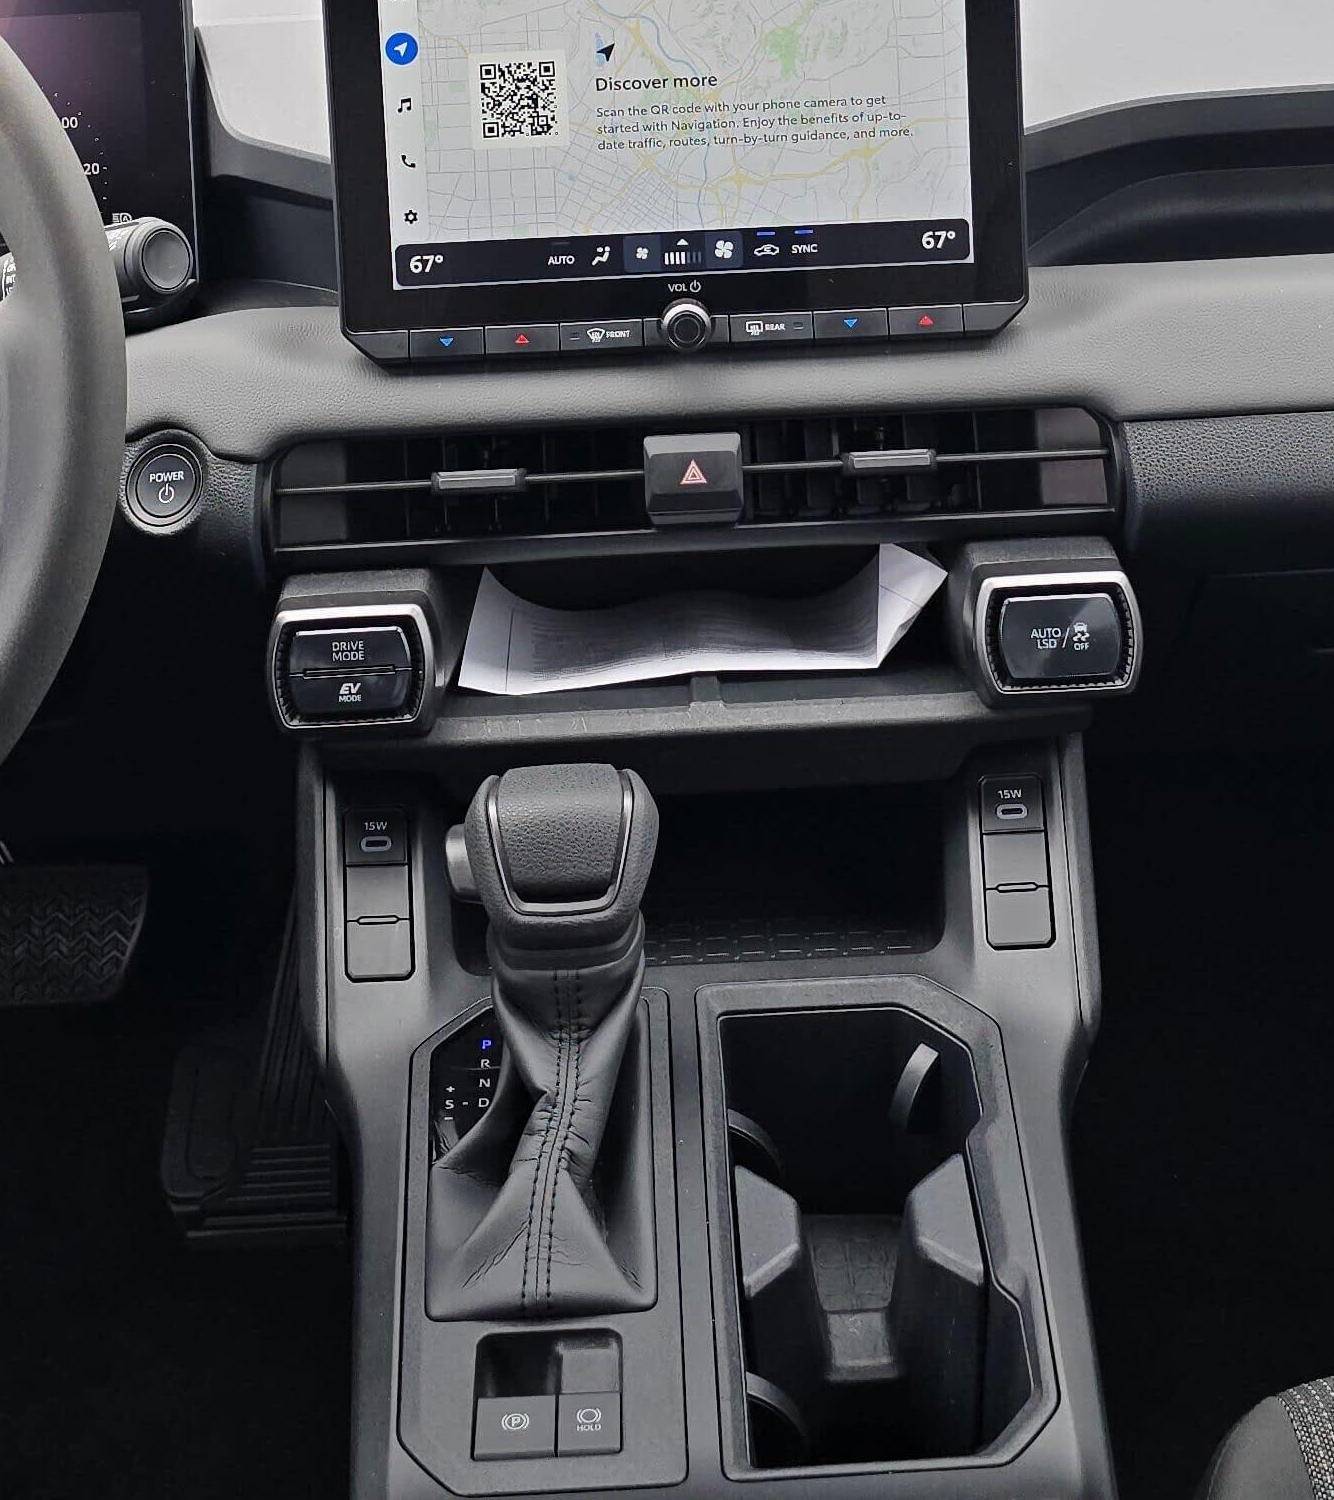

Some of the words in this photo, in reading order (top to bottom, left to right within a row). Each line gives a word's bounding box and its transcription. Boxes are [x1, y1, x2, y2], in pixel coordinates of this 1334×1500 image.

[596, 77, 669, 92] Discover
[673, 76, 718, 88] more
[596, 107, 624, 118] Scan
[628, 106, 648, 117] the
[650, 105, 669, 116] QR
[672, 103, 702, 115] code
[704, 102, 730, 113] with
[732, 102, 760, 114] your
[762, 99, 801, 114] phone
[803, 99, 848, 109] camera
[851, 97, 864, 106] to
[866, 96, 886, 108] get
[597, 121, 639, 134] started
[642, 121, 668, 132] with
[671, 117, 739, 131] Navigation.
[743, 116, 775, 130] Enjoy
[778, 115, 798, 126] the
[800, 113, 849, 125] benefits
[852, 112, 865, 123] of
[866, 111, 907, 125] up-to-
[598, 138, 625, 150] date
[628, 136, 666, 150] traffic,
[669, 135, 710, 148] routes,
[714, 131, 788, 147] turn-by-turn
[791, 129, 850, 145] guidance,
[853, 127, 877, 139] and
[879, 127, 914, 139] more.
[921, 230, 957, 251] 67°
[548, 255, 575, 266] AUTO
[791, 243, 818, 255] SYNC
[409, 254, 444, 275] 67°
[668, 283, 688, 293] VOL
[764, 322, 785, 331] REAR
[606, 329, 630, 339] FRONT
[149, 470, 185, 483] POWER
[1030, 627, 1062, 639] AUTO
[332, 640, 365, 651] DRIVE
[1037, 638, 1058, 649] LSD
[1073, 642, 1090, 651] OFF
[332, 651, 365, 661] MODE
[339, 682, 362, 695] EV
[338, 694, 362, 703] MODE
[997, 788, 1022, 799] 15W
[363, 821, 388, 831] 15W
[481, 1039, 492, 1050] P
[480, 1059, 491, 1069] R
[479, 1078, 491, 1088] N
[445, 1099, 455, 1110] S
[478, 1097, 490, 1108] D
[576, 1424, 602, 1432] HOLD
